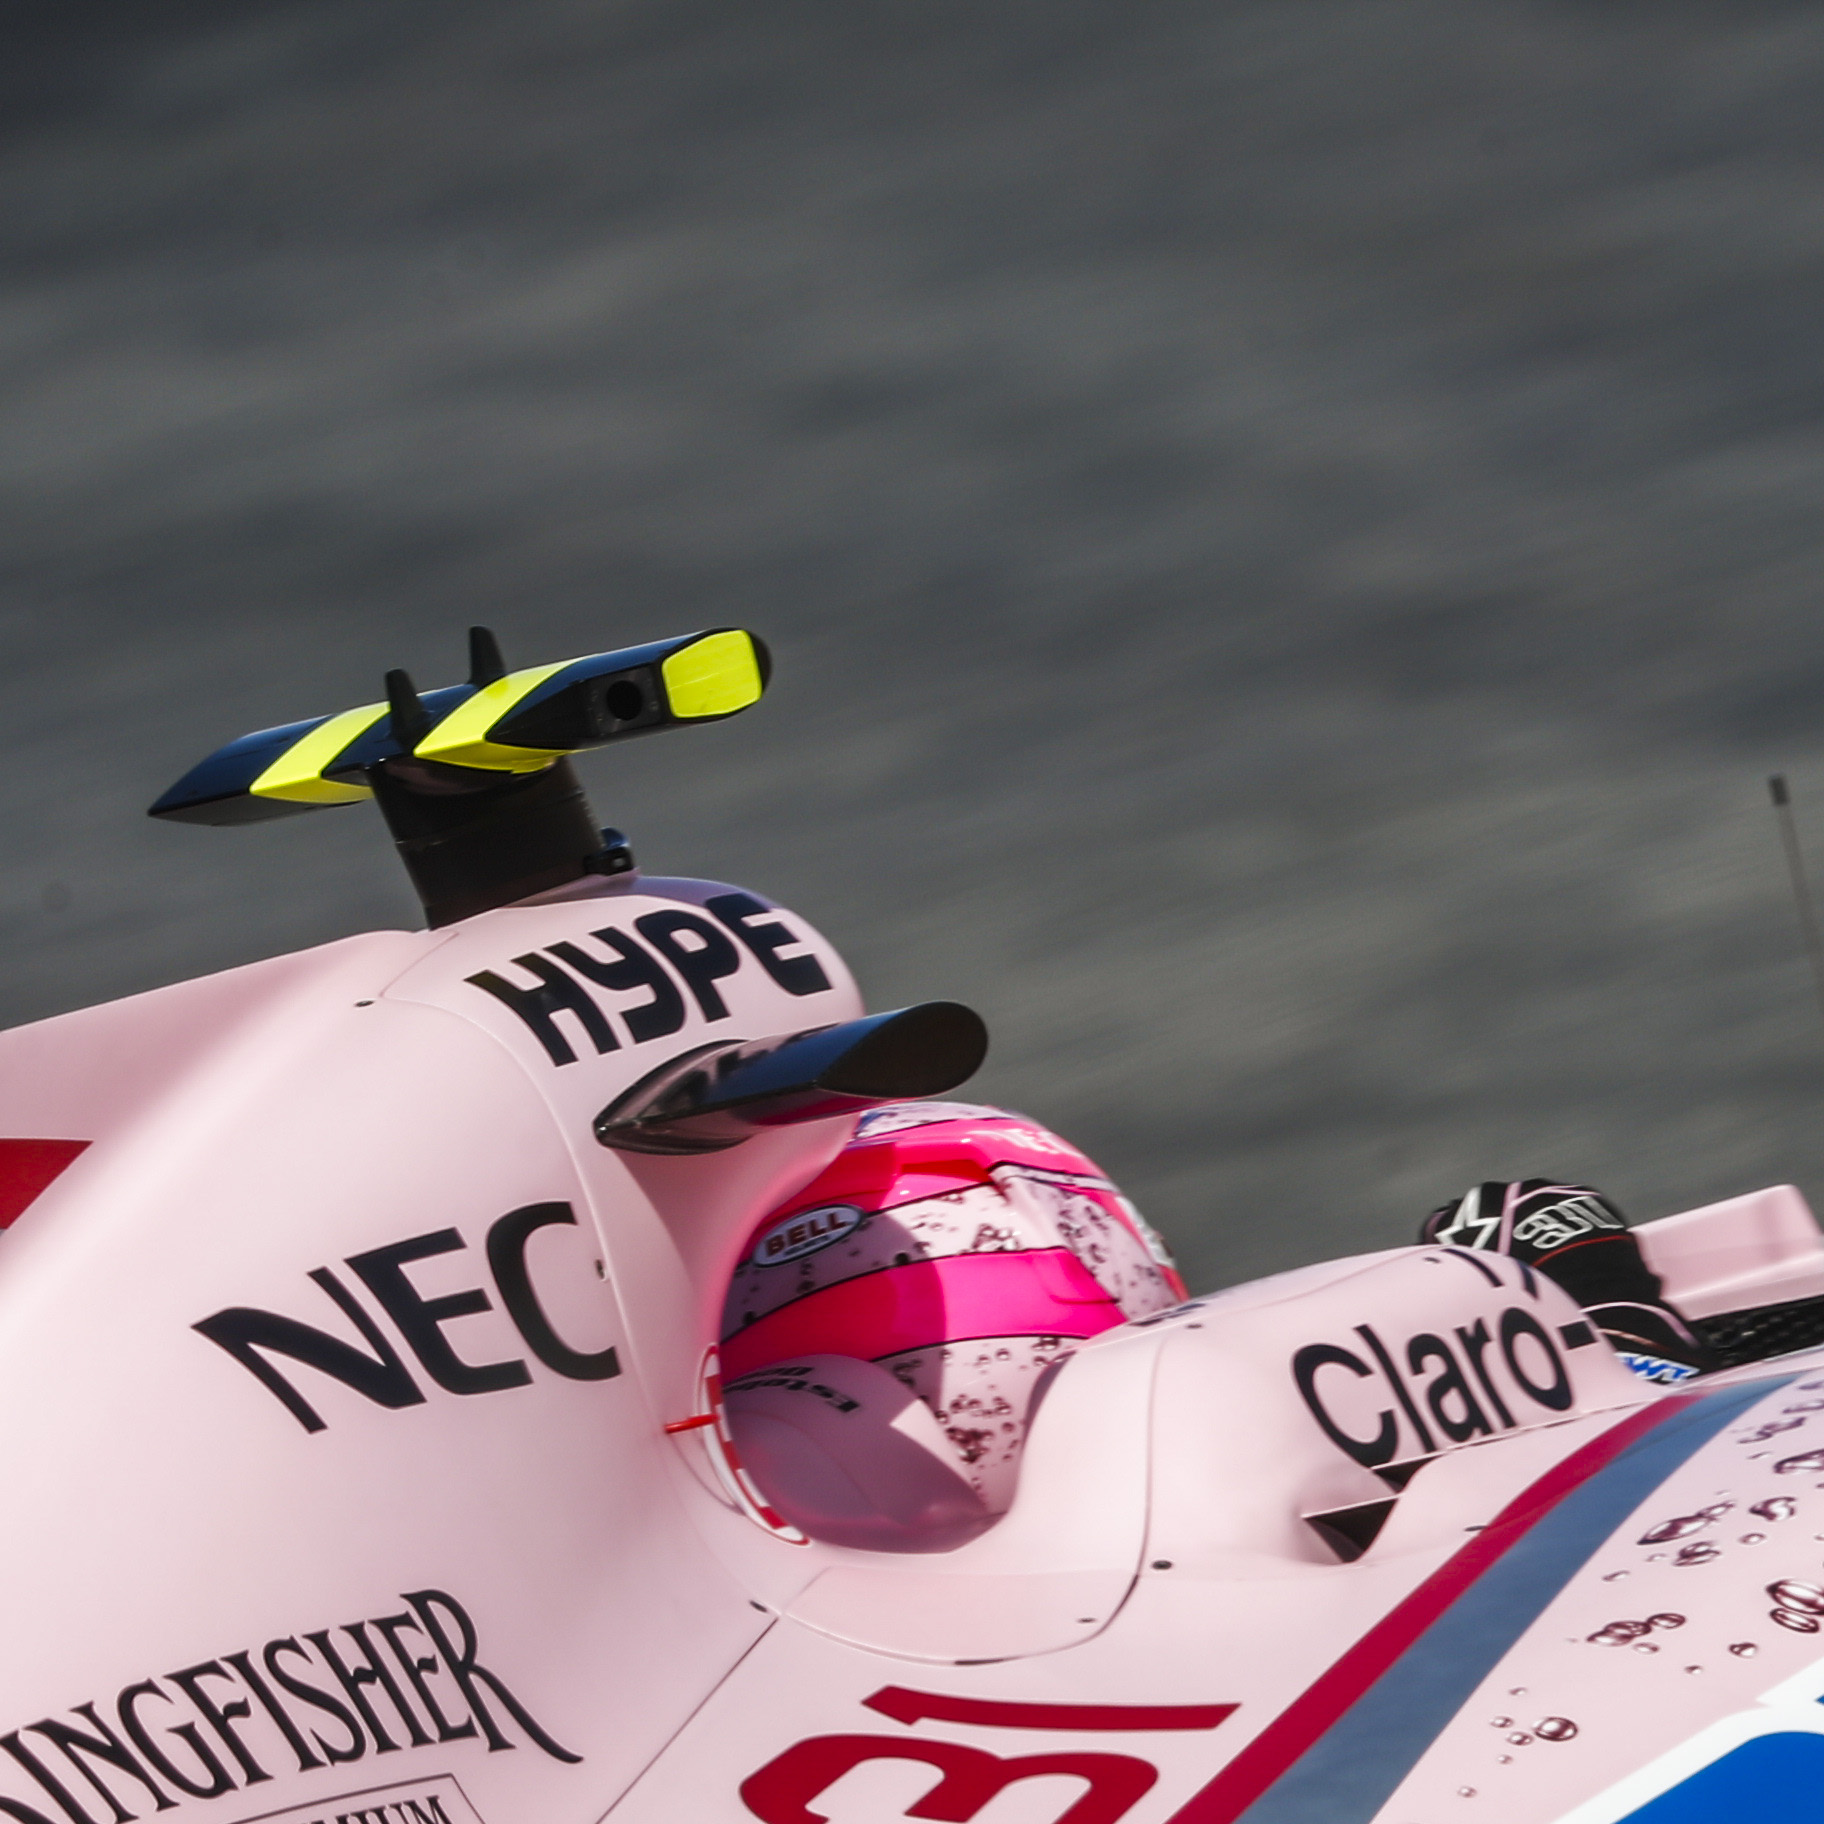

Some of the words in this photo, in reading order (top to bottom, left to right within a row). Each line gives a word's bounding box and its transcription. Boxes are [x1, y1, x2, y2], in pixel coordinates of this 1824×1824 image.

[463, 892, 834, 1068] HYPE
[765, 1211, 848, 1258] BELL
[190, 1200, 623, 1435] NEC
[1618, 1352, 1698, 1383] WT
